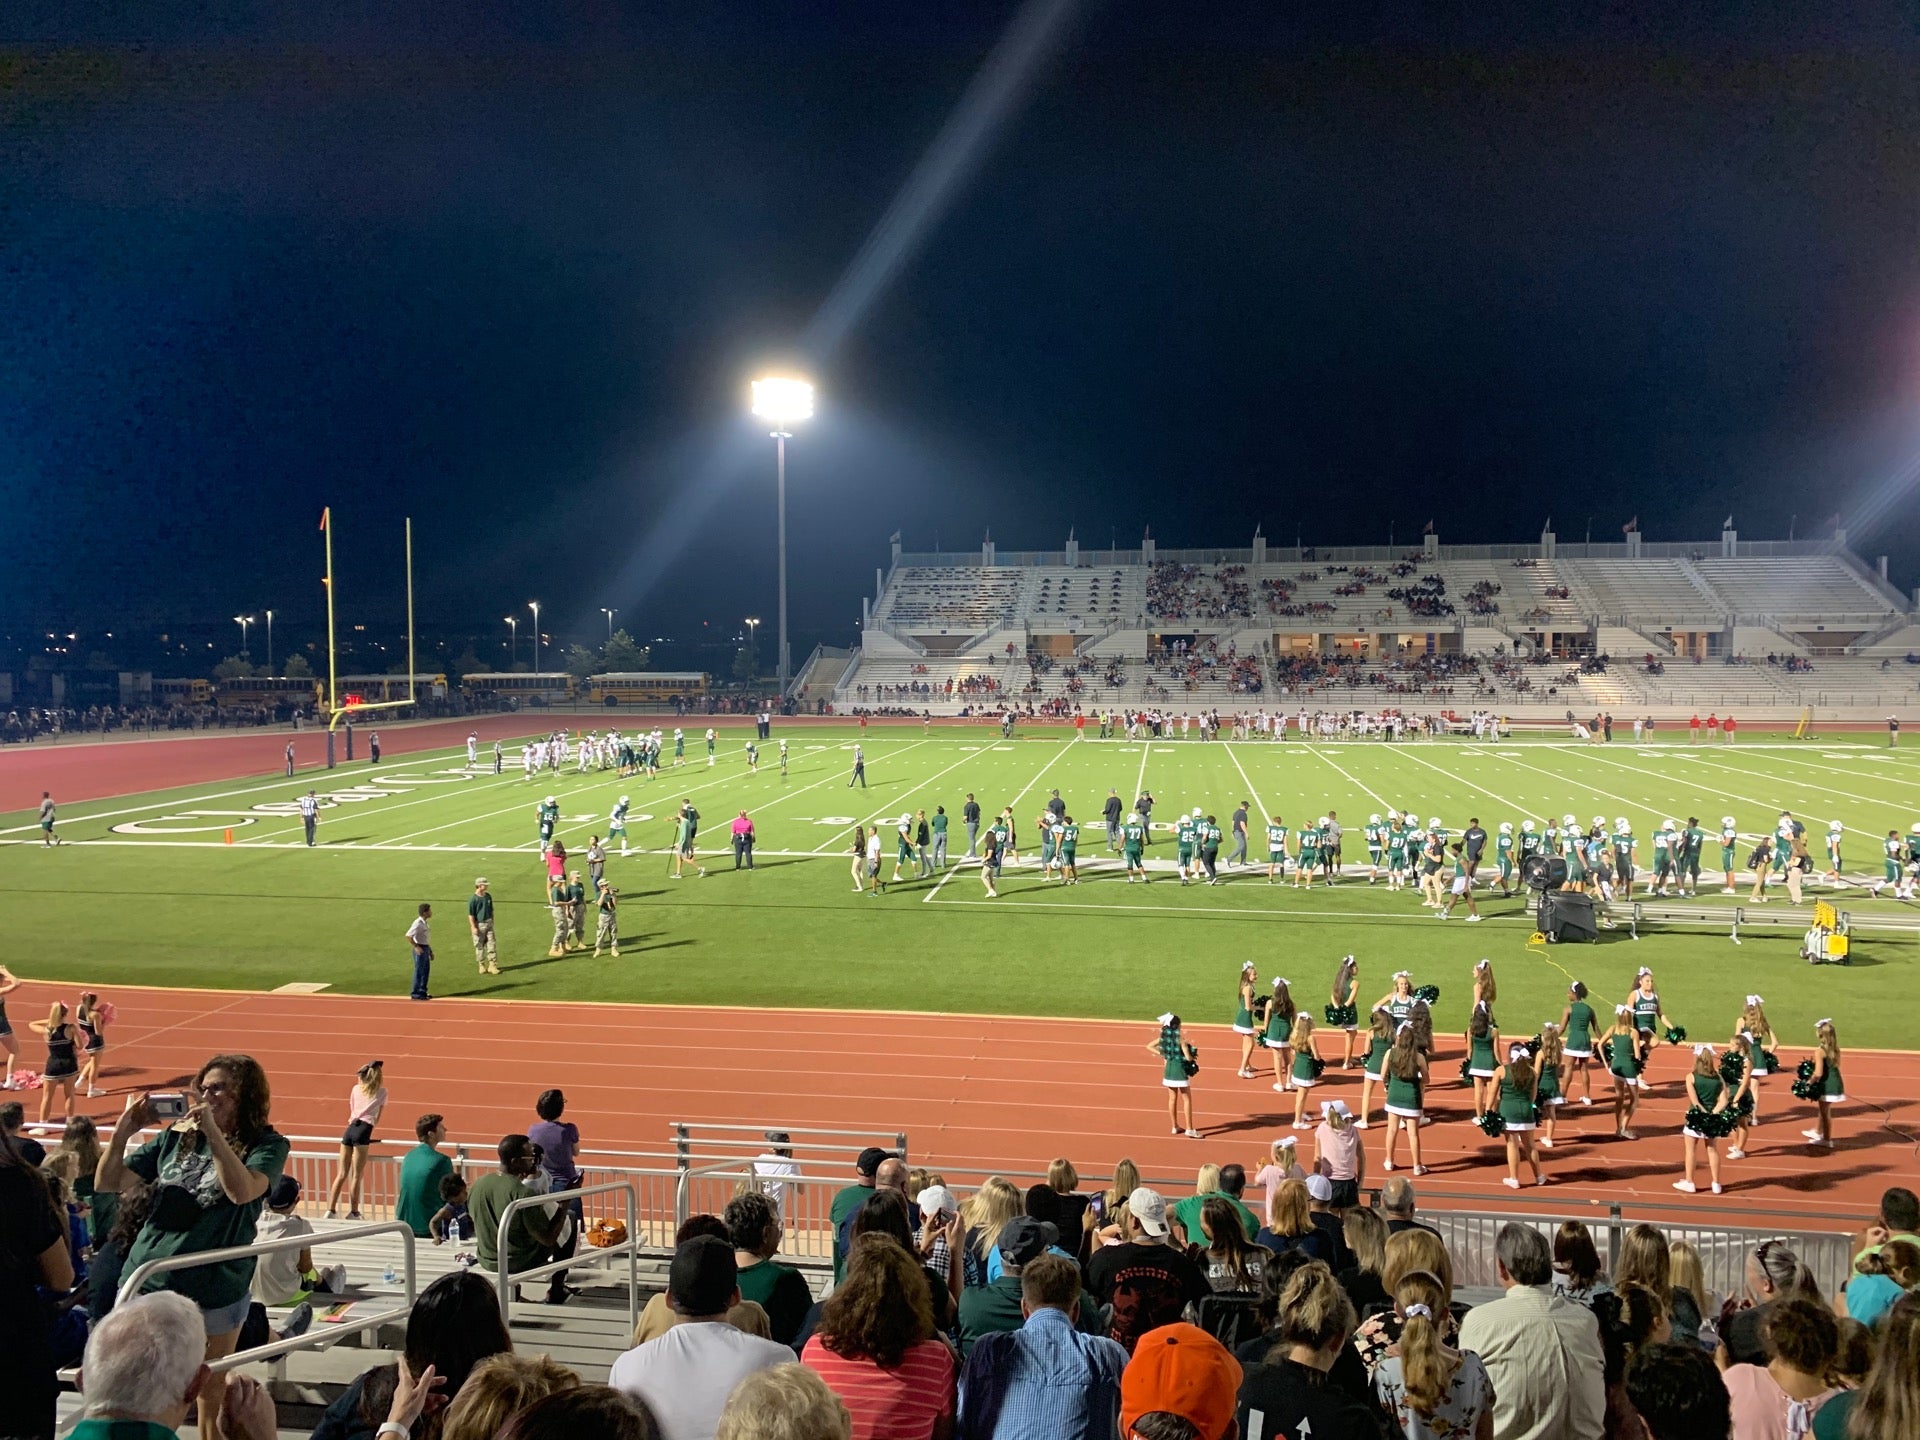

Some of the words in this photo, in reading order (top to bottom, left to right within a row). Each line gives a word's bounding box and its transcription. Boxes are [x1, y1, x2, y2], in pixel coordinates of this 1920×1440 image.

[1128, 828, 1142, 839] 77
[1270, 829, 1284, 841] 23
[1302, 835, 1317, 846] 47
[1691, 836, 1700, 848] 7
